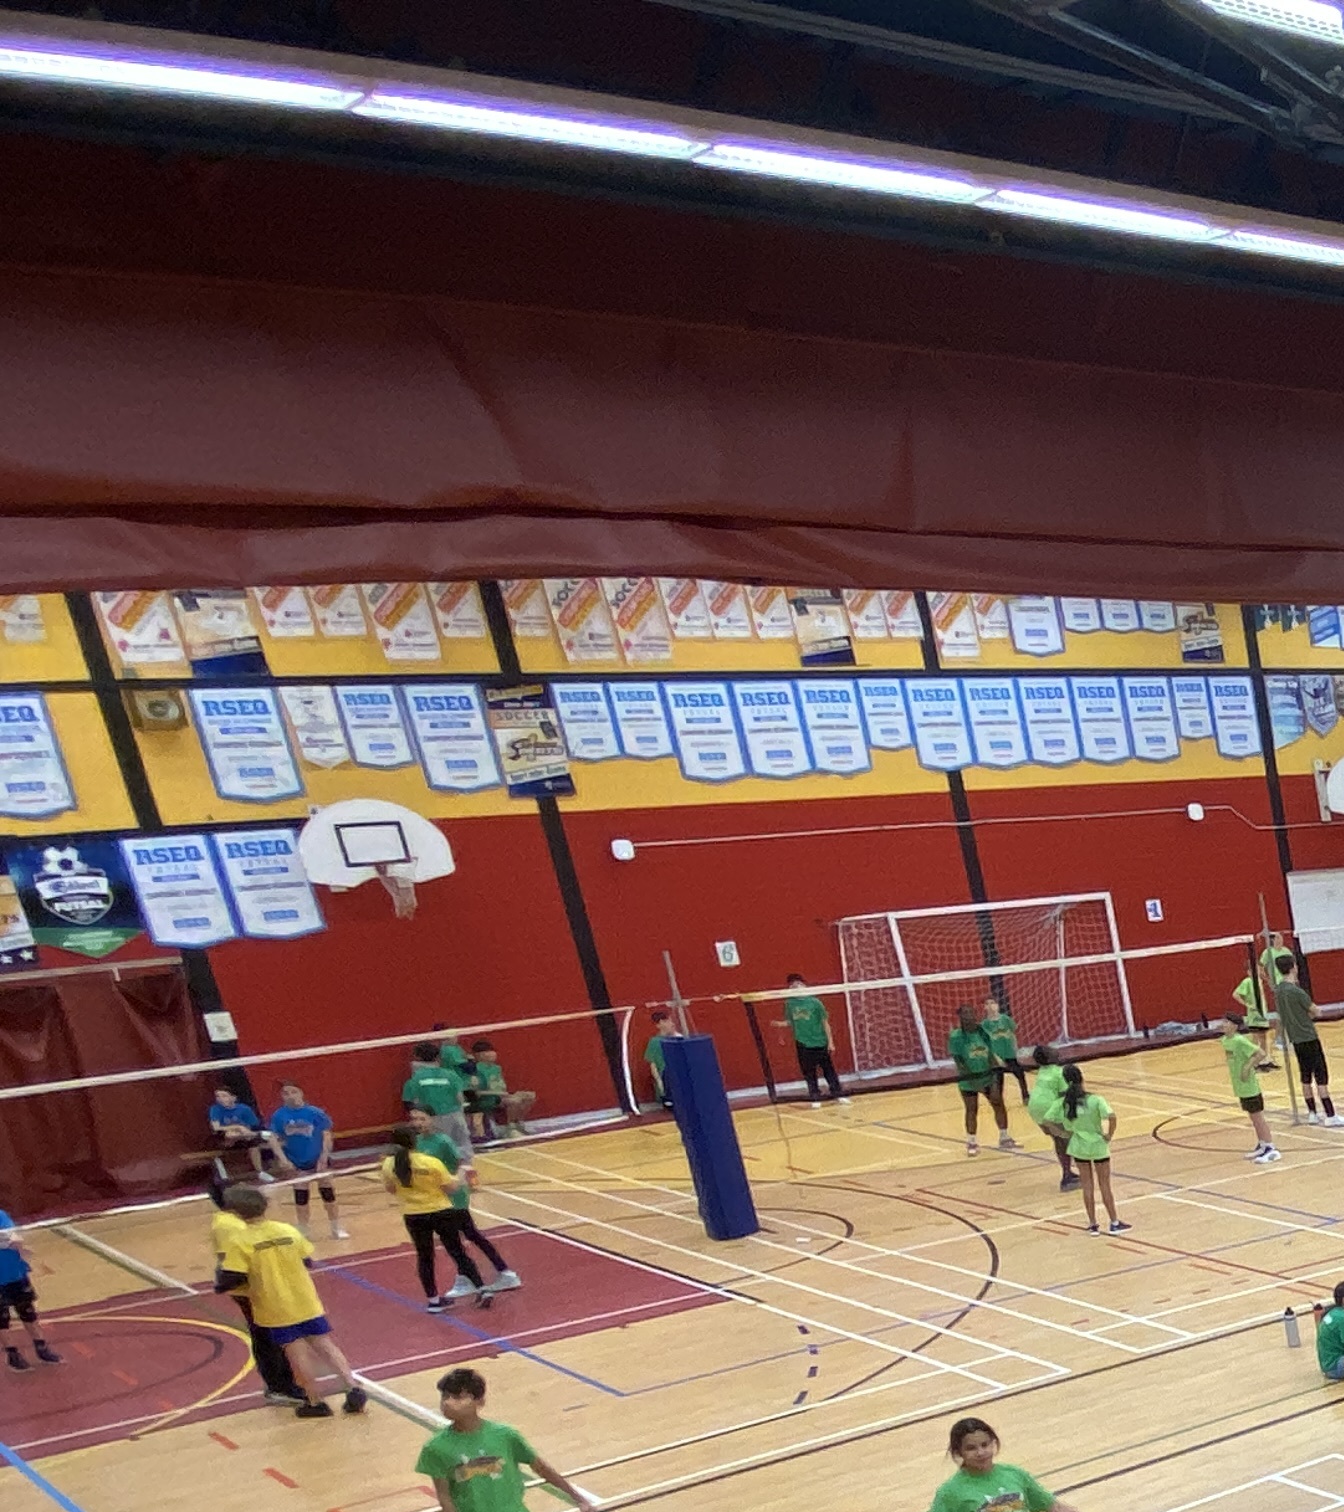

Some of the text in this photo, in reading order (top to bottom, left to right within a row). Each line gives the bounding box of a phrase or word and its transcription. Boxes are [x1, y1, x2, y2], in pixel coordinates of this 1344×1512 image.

[804, 690, 850, 703] RSEQ
[865, 686, 897, 696] RSEQ
[912, 688, 955, 701] RSEQ
[969, 687, 1011, 700] RSEQ
[1025, 686, 1065, 699] RSEQ
[1077, 686, 1116, 699] RSEQ
[1129, 685, 1166, 698] RSEQ
[1214, 684, 1249, 697] RSEQ
[343, 693, 391, 706] RSEQ
[413, 696, 473, 712] RSEQ
[674, 693, 723, 708] RSEQ
[741, 692, 788, 707] RSEQ
[0, 706, 40, 722] EQ
[203, 700, 272, 716] RSEQ
[224, 840, 293, 857] RSEQ
[135, 846, 204, 865] RSEQ
